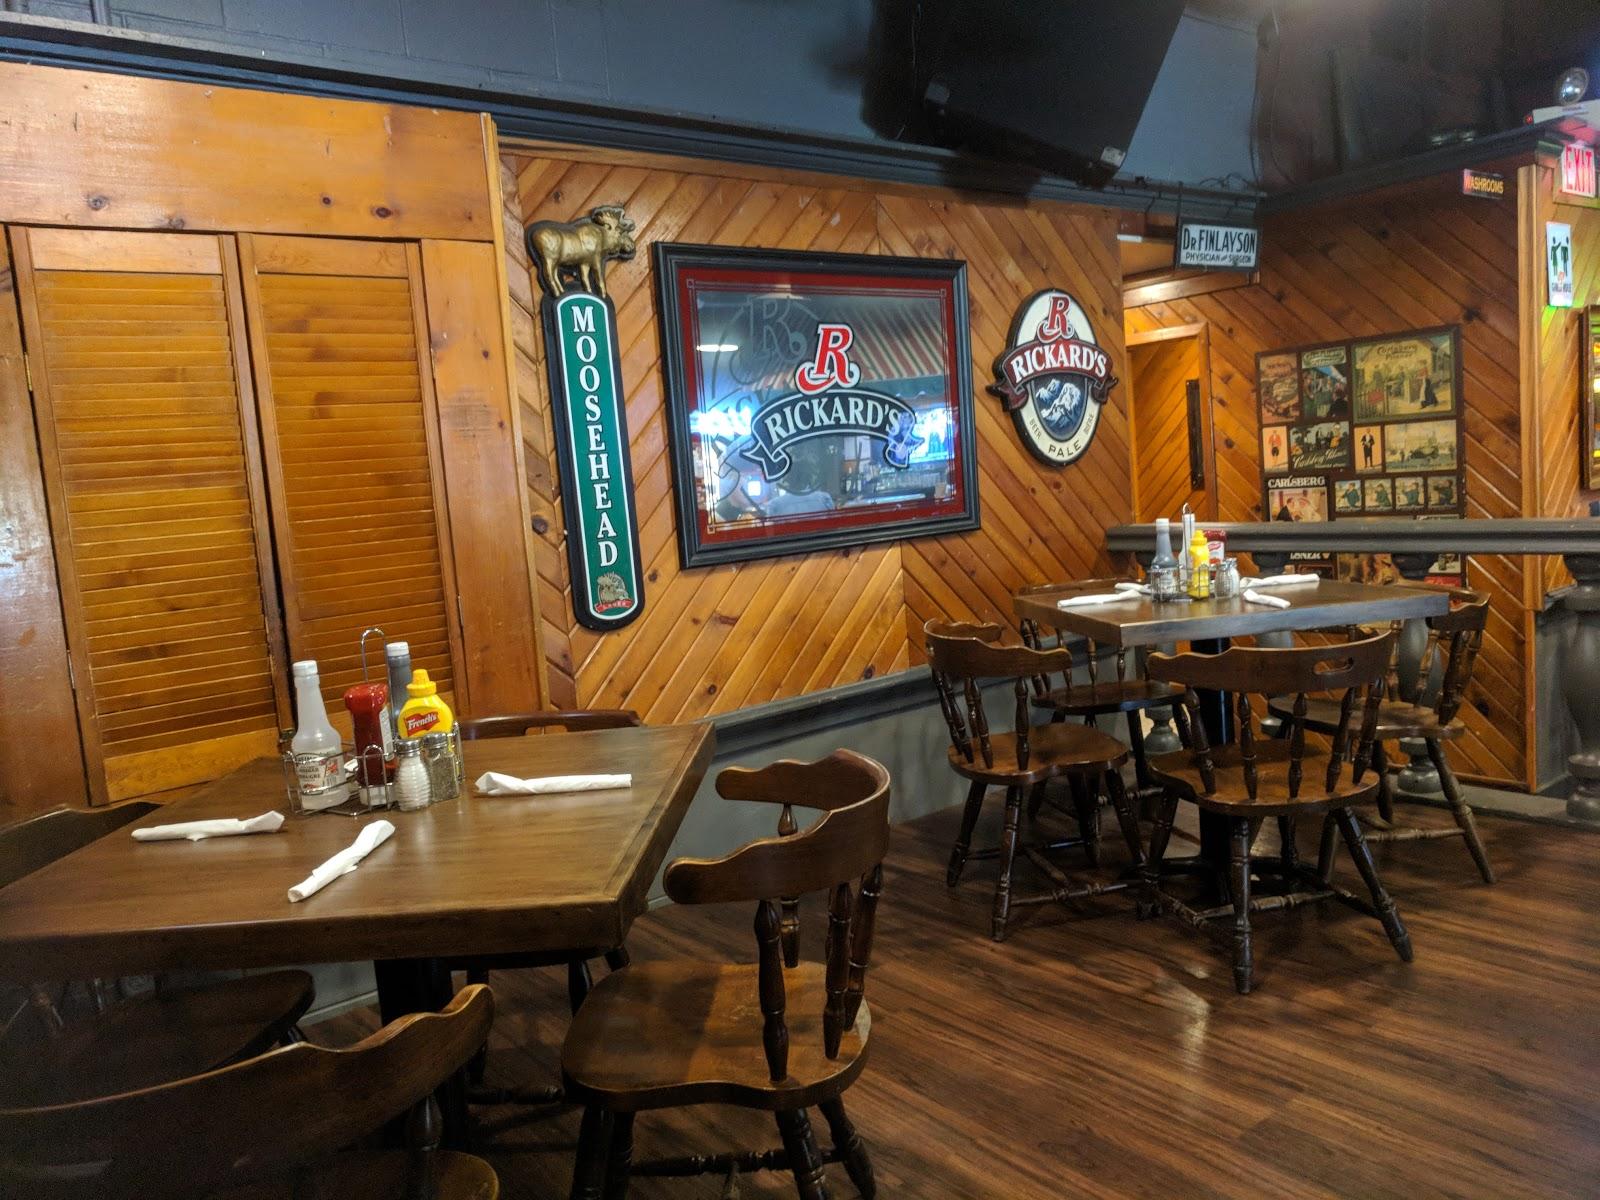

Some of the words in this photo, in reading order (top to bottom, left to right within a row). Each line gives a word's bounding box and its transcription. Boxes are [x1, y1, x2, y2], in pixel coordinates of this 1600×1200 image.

[1464, 175, 1504, 194] WASHROOMS
[1564, 145, 1594, 194] EXIT
[1185, 251, 1220, 262] PHYSICIAN
[1198, 229, 1256, 254] FINLAYSON
[1036, 296, 1073, 343] R
[797, 322, 861, 394] R
[1010, 343, 1107, 382] RICKARD'S
[571, 305, 618, 568] MOOSEHEAD
[764, 395, 902, 444] RICKARD'S
[1029, 417, 1042, 440] BEER
[1048, 440, 1082, 458] PALE
[1267, 475, 1326, 488] CARLSBERG
[407, 713, 437, 730] French's
